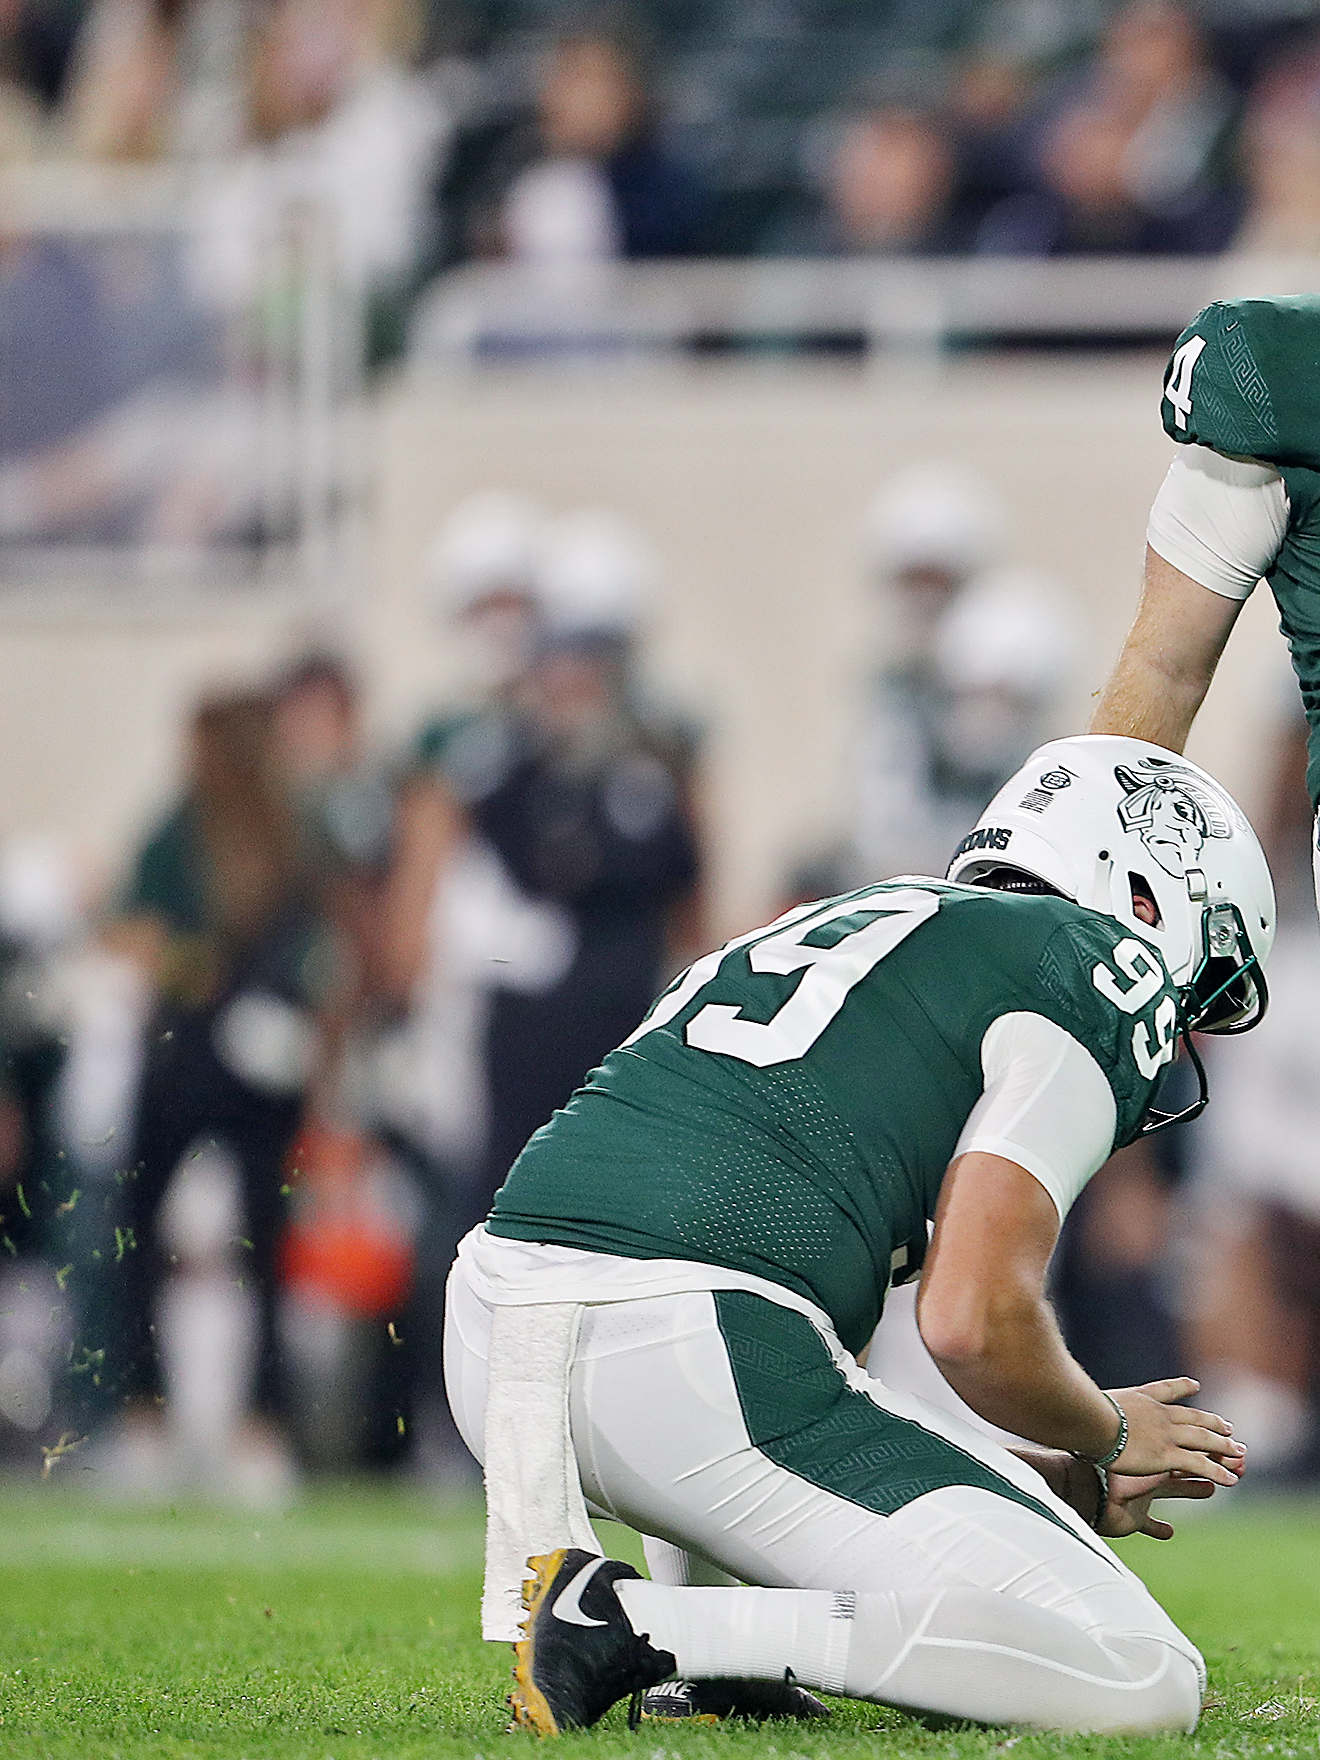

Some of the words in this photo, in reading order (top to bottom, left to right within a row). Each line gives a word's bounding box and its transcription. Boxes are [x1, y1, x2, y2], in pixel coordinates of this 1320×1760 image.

[1164, 334, 1207, 431] 4
[1092, 937, 1176, 1081] 99
[646, 1680, 698, 1699] NIKE
